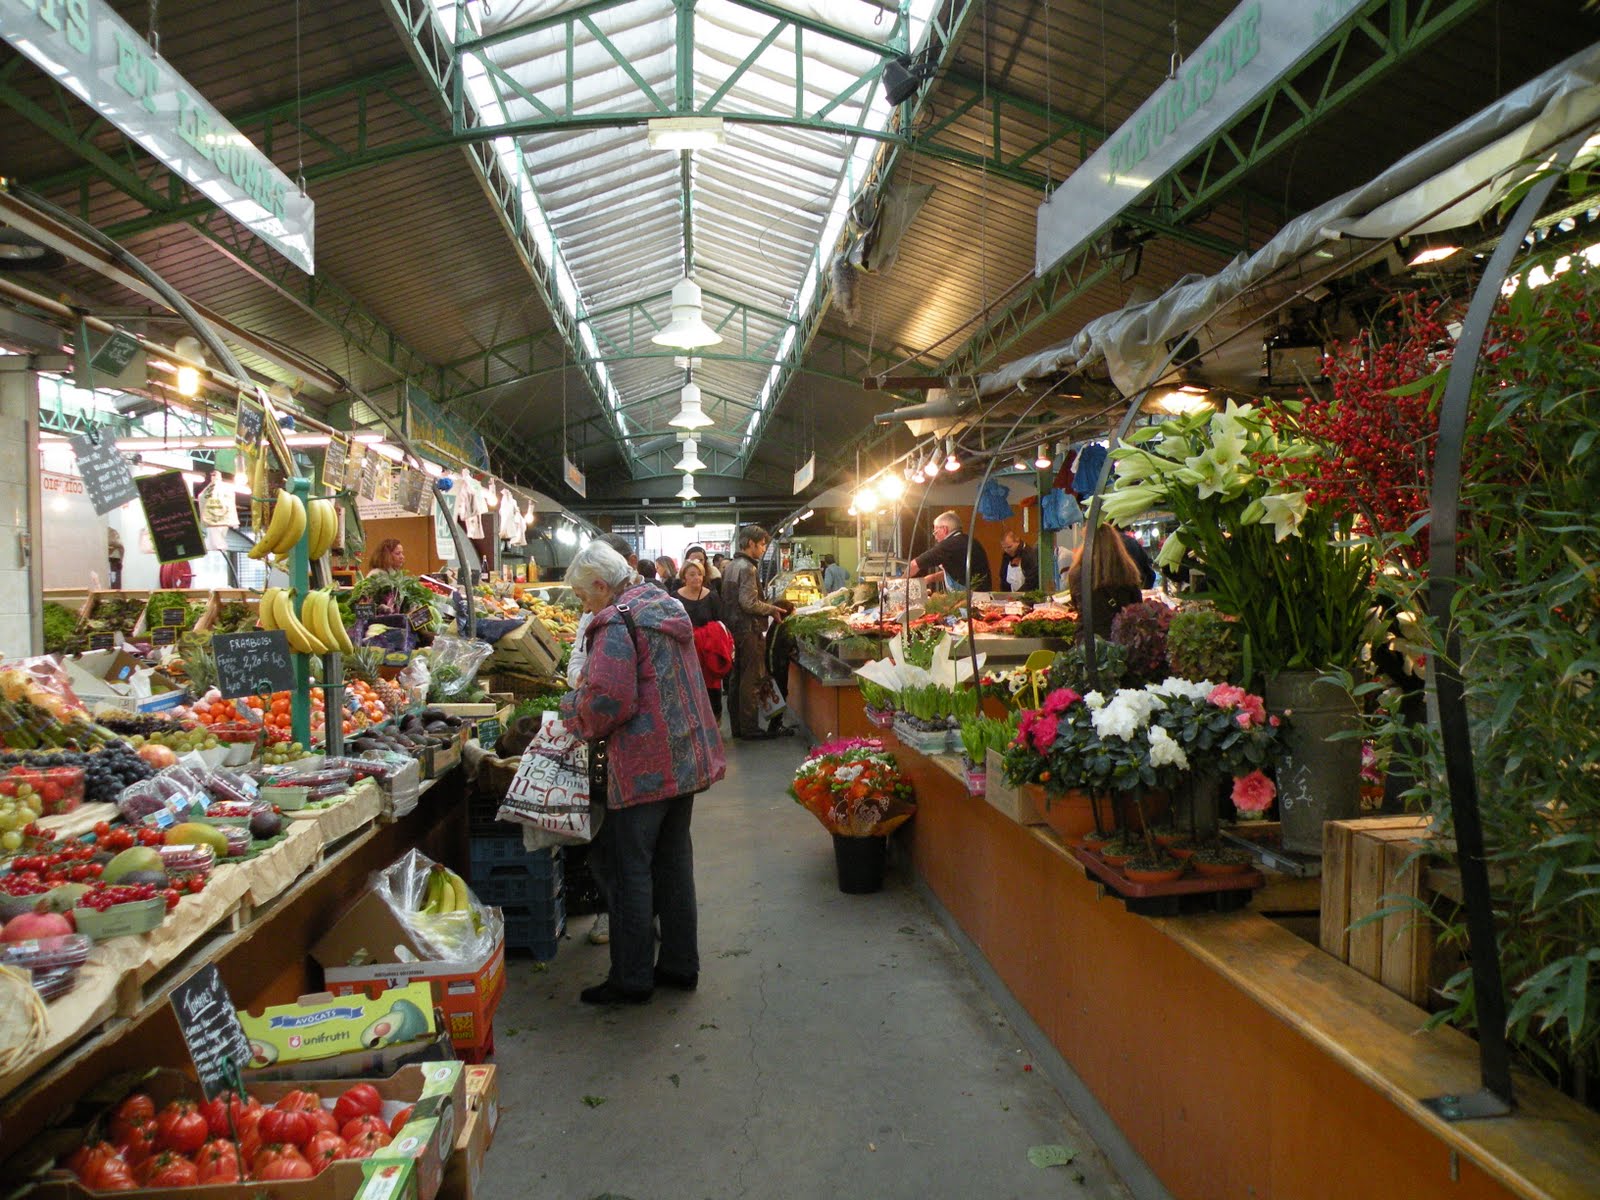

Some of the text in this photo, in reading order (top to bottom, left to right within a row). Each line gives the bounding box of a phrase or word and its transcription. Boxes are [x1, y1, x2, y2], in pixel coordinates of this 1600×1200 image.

[114, 31, 160, 115] ET
[1107, 3, 1260, 186] FLEURISTE
[295, 1008, 336, 1026] AVOCATS
[304, 1030, 349, 1047] unifrutti
